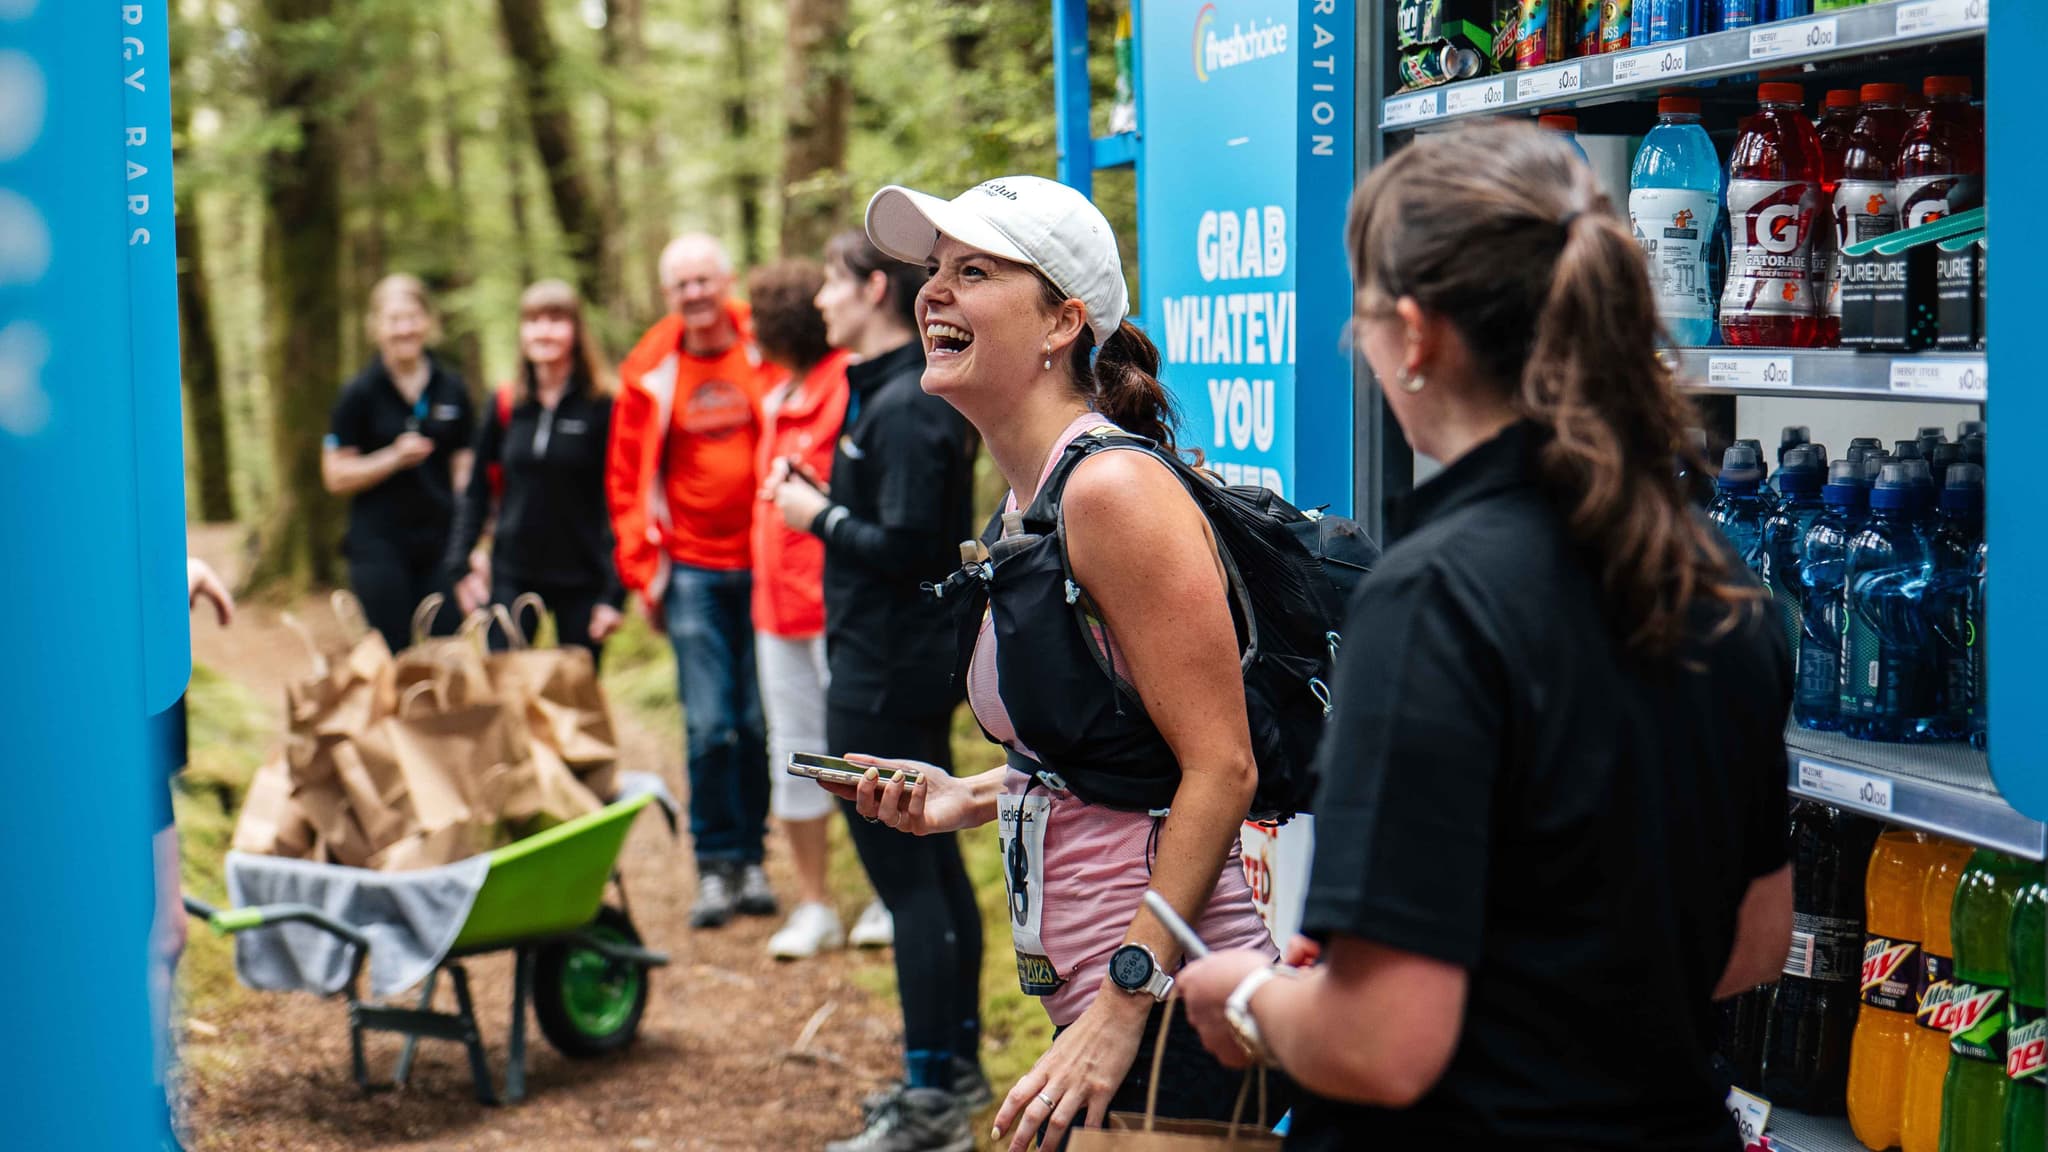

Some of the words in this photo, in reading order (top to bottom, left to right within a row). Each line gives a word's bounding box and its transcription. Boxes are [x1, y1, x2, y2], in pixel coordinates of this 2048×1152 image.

[1205, 15, 1288, 73] freshchoice
[1807, 25, 1832, 47] $0.00
[1661, 52, 1684, 72] $0.00
[1558, 70, 1578, 89] $0.00
[1484, 86, 1502, 104] $0.00
[989, 184, 1018, 201] club
[1755, 204, 1799, 254] G
[1196, 204, 1287, 283] GRAB
[1744, 254, 1807, 268] GATORADE
[1874, 262, 1907, 281] PURE
[1937, 257, 1971, 279] PURE
[1840, 263, 1875, 282] PURE
[1763, 362, 1788, 383] $0.00
[1206, 376, 1275, 453] YOU
[1858, 781, 1887, 807] $0.00
[1001, 805, 1024, 830] keple
[1025, 957, 1054, 985] 2023
